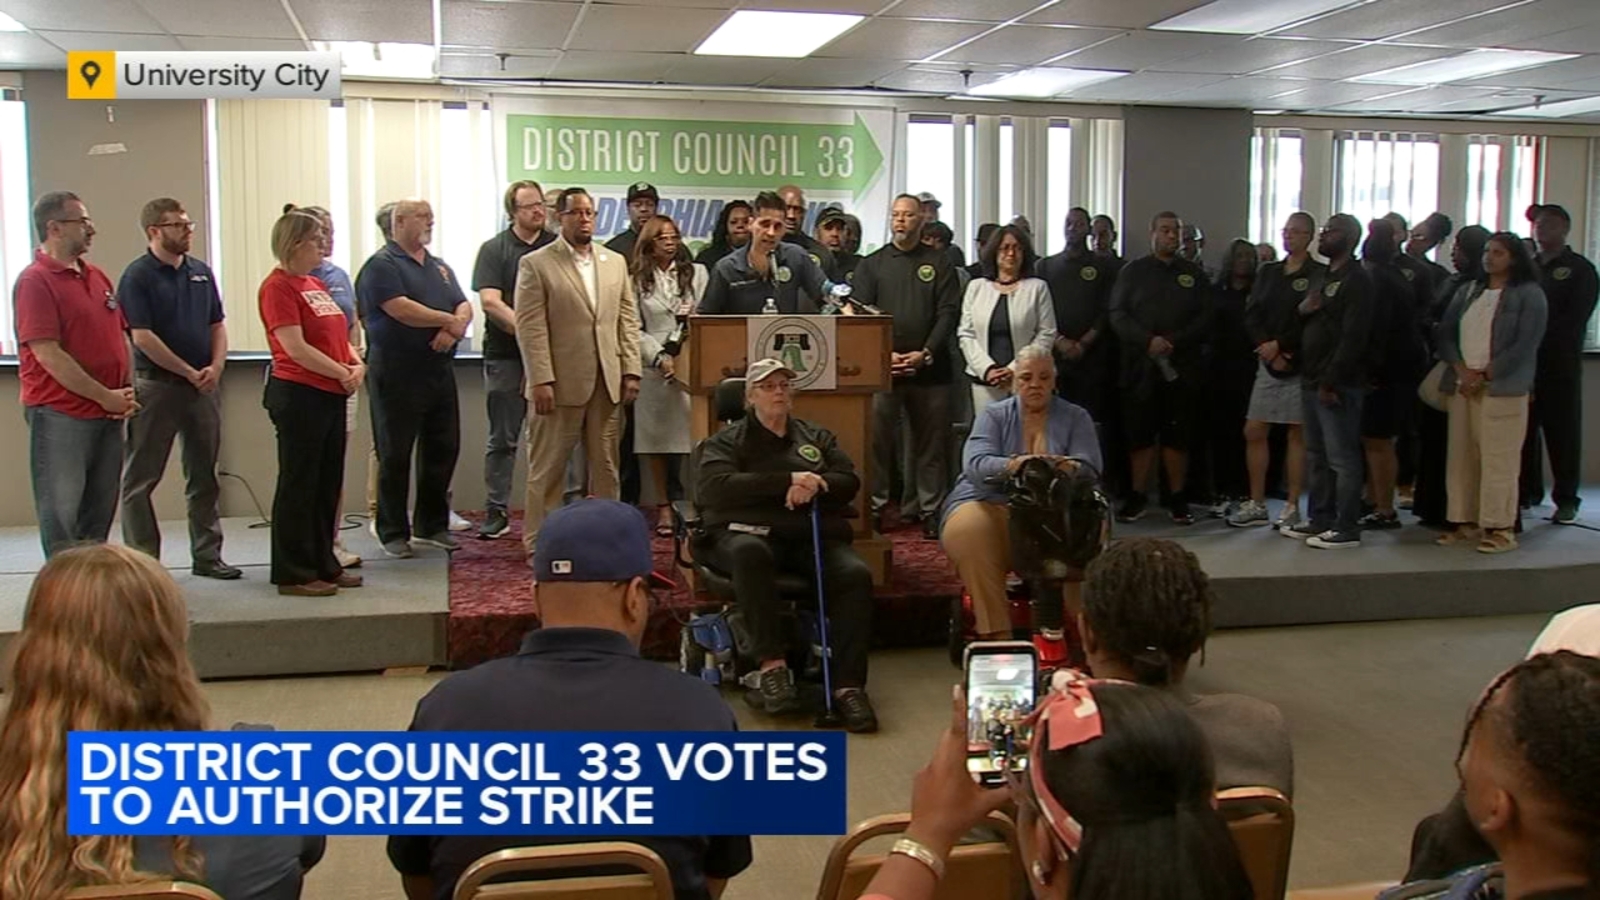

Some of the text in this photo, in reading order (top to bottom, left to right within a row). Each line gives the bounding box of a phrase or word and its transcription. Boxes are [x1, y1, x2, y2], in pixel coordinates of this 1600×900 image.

[523, 127, 854, 178] DISTRICT COUNCIL 33
